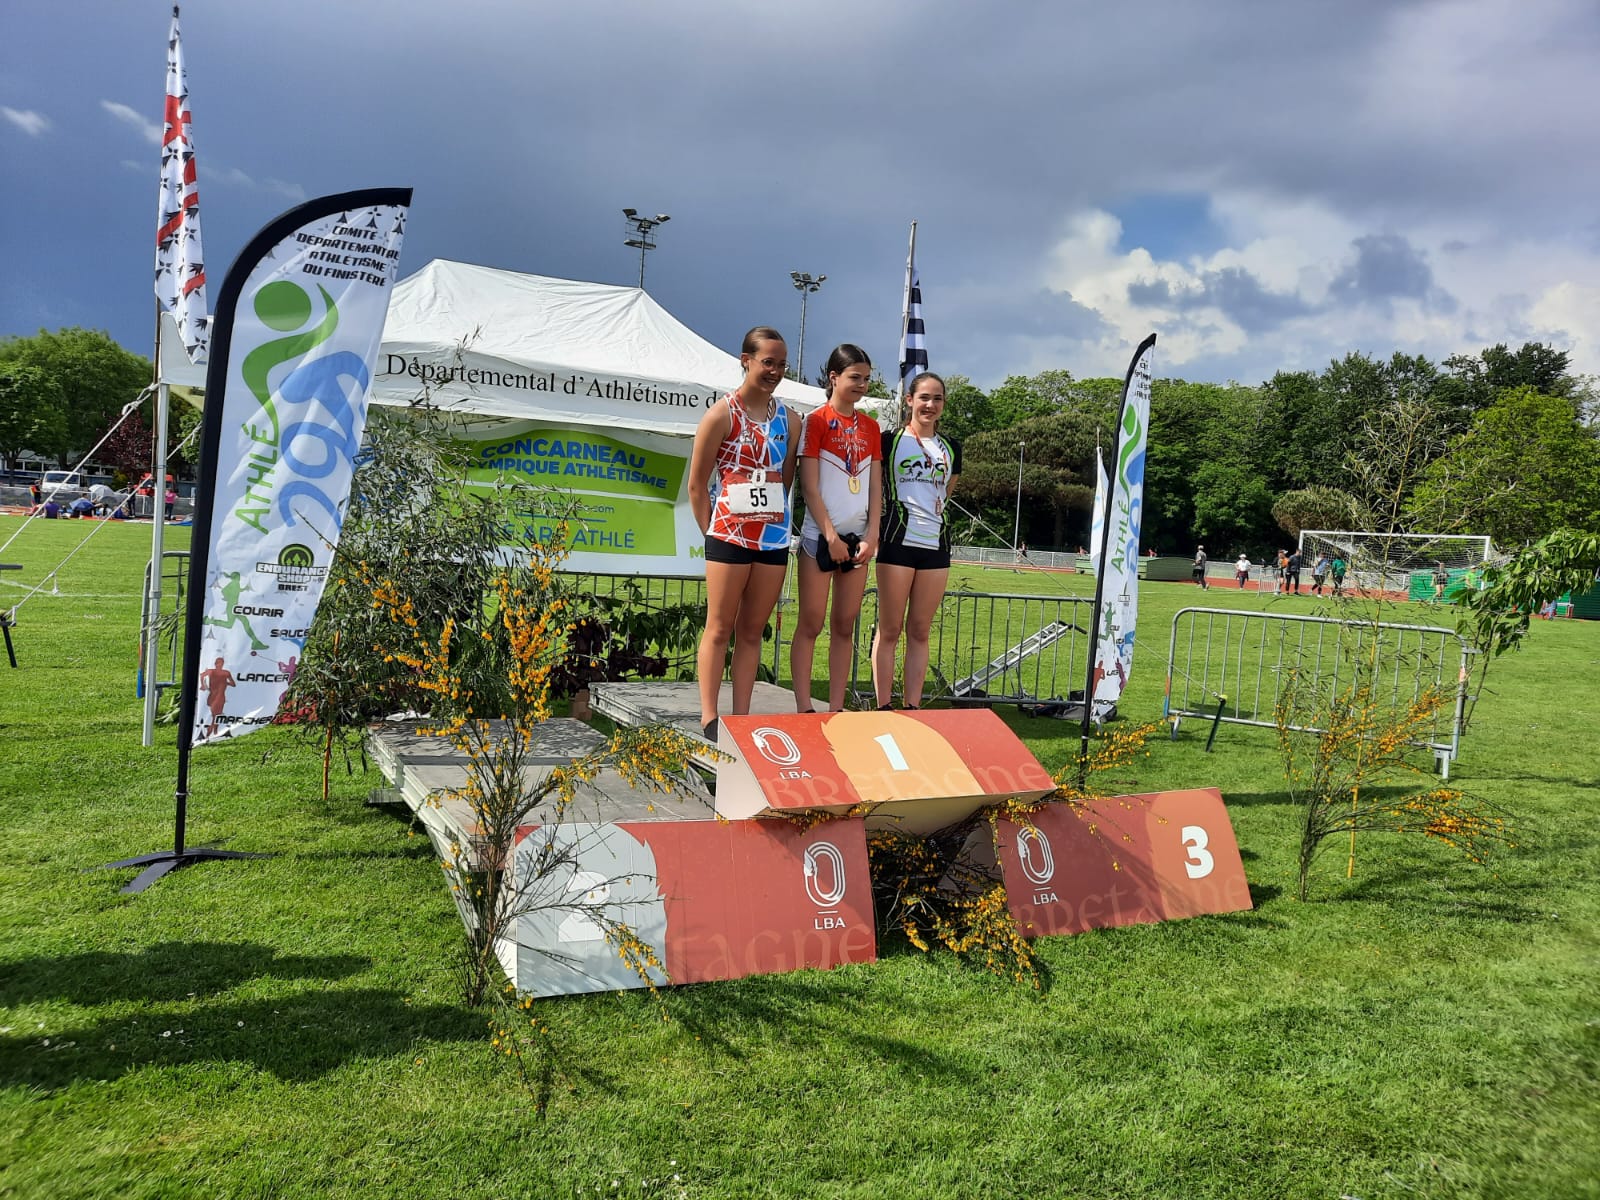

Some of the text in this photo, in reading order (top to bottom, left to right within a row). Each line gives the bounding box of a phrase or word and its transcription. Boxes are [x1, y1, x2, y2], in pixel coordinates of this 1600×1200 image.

[296, 232, 400, 260] DEPARTEMENTAL
[302, 263, 323, 275] DU
[386, 354, 556, 393] Départemental
[705, 391, 725, 409] d
[480, 438, 646, 469] CONCARNEAU
[235, 423, 279, 535] ATHLÉ
[563, 462, 668, 489] ATHLÉTISME
[749, 488, 768, 507] 55
[572, 528, 636, 549] ATHLÉ
[278, 573, 311, 583] SHOP
[278, 583, 308, 592] BREST
[233, 605, 284, 618] COURIR
[236, 672, 289, 683] LANCER
[872, 733, 910, 771] 1
[779, 770, 812, 780] LBA
[1181, 825, 1215, 879] 3
[1032, 892, 1059, 905] LBA
[814, 917, 846, 930] LBA
